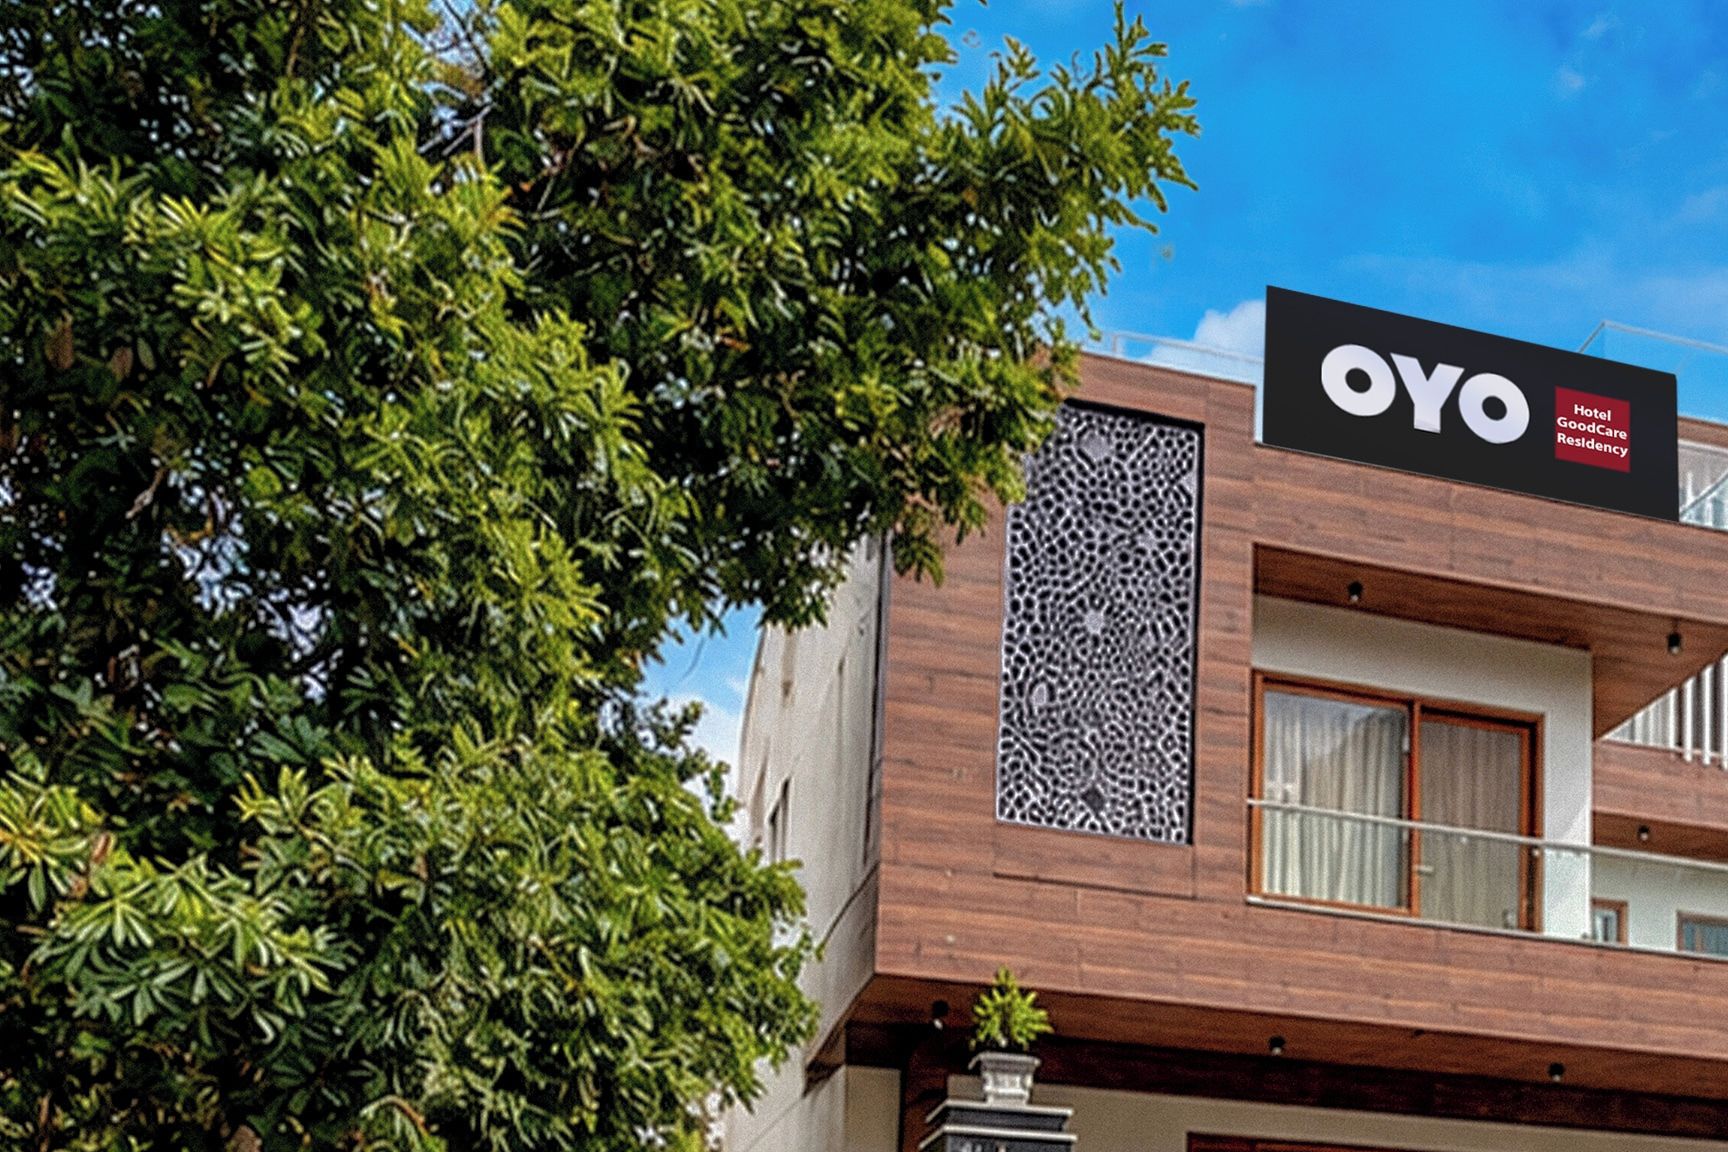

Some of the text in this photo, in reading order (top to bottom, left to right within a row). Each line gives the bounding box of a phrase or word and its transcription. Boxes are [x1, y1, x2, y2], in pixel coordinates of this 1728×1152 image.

[1321, 344, 1530, 444] OYO
[1573, 403, 1612, 422] Hotel
[1556, 416, 1628, 440] GoodCare
[1557, 432, 1629, 458] Residency
